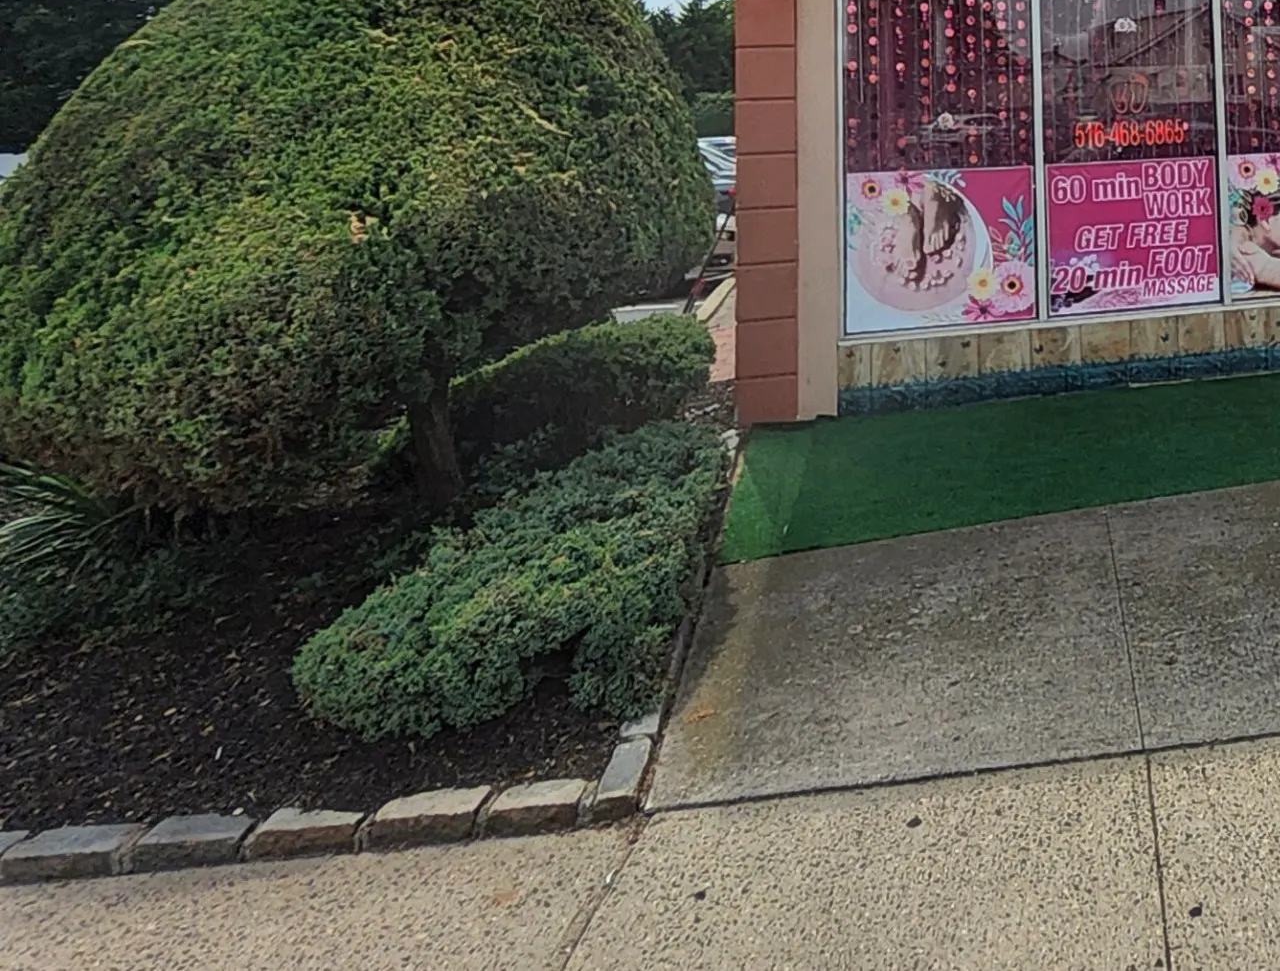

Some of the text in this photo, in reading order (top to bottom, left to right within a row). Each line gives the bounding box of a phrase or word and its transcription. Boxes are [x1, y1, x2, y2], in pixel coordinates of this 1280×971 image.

[1074, 118, 1184, 148] 516-468-6865
[1052, 160, 1209, 204] 60 min BODY
[1144, 188, 1212, 219] WORK
[1075, 220, 1188, 252] GET FREE
[1052, 245, 1213, 294] 20 min FOOT
[1142, 273, 1215, 297] MASSAGE
